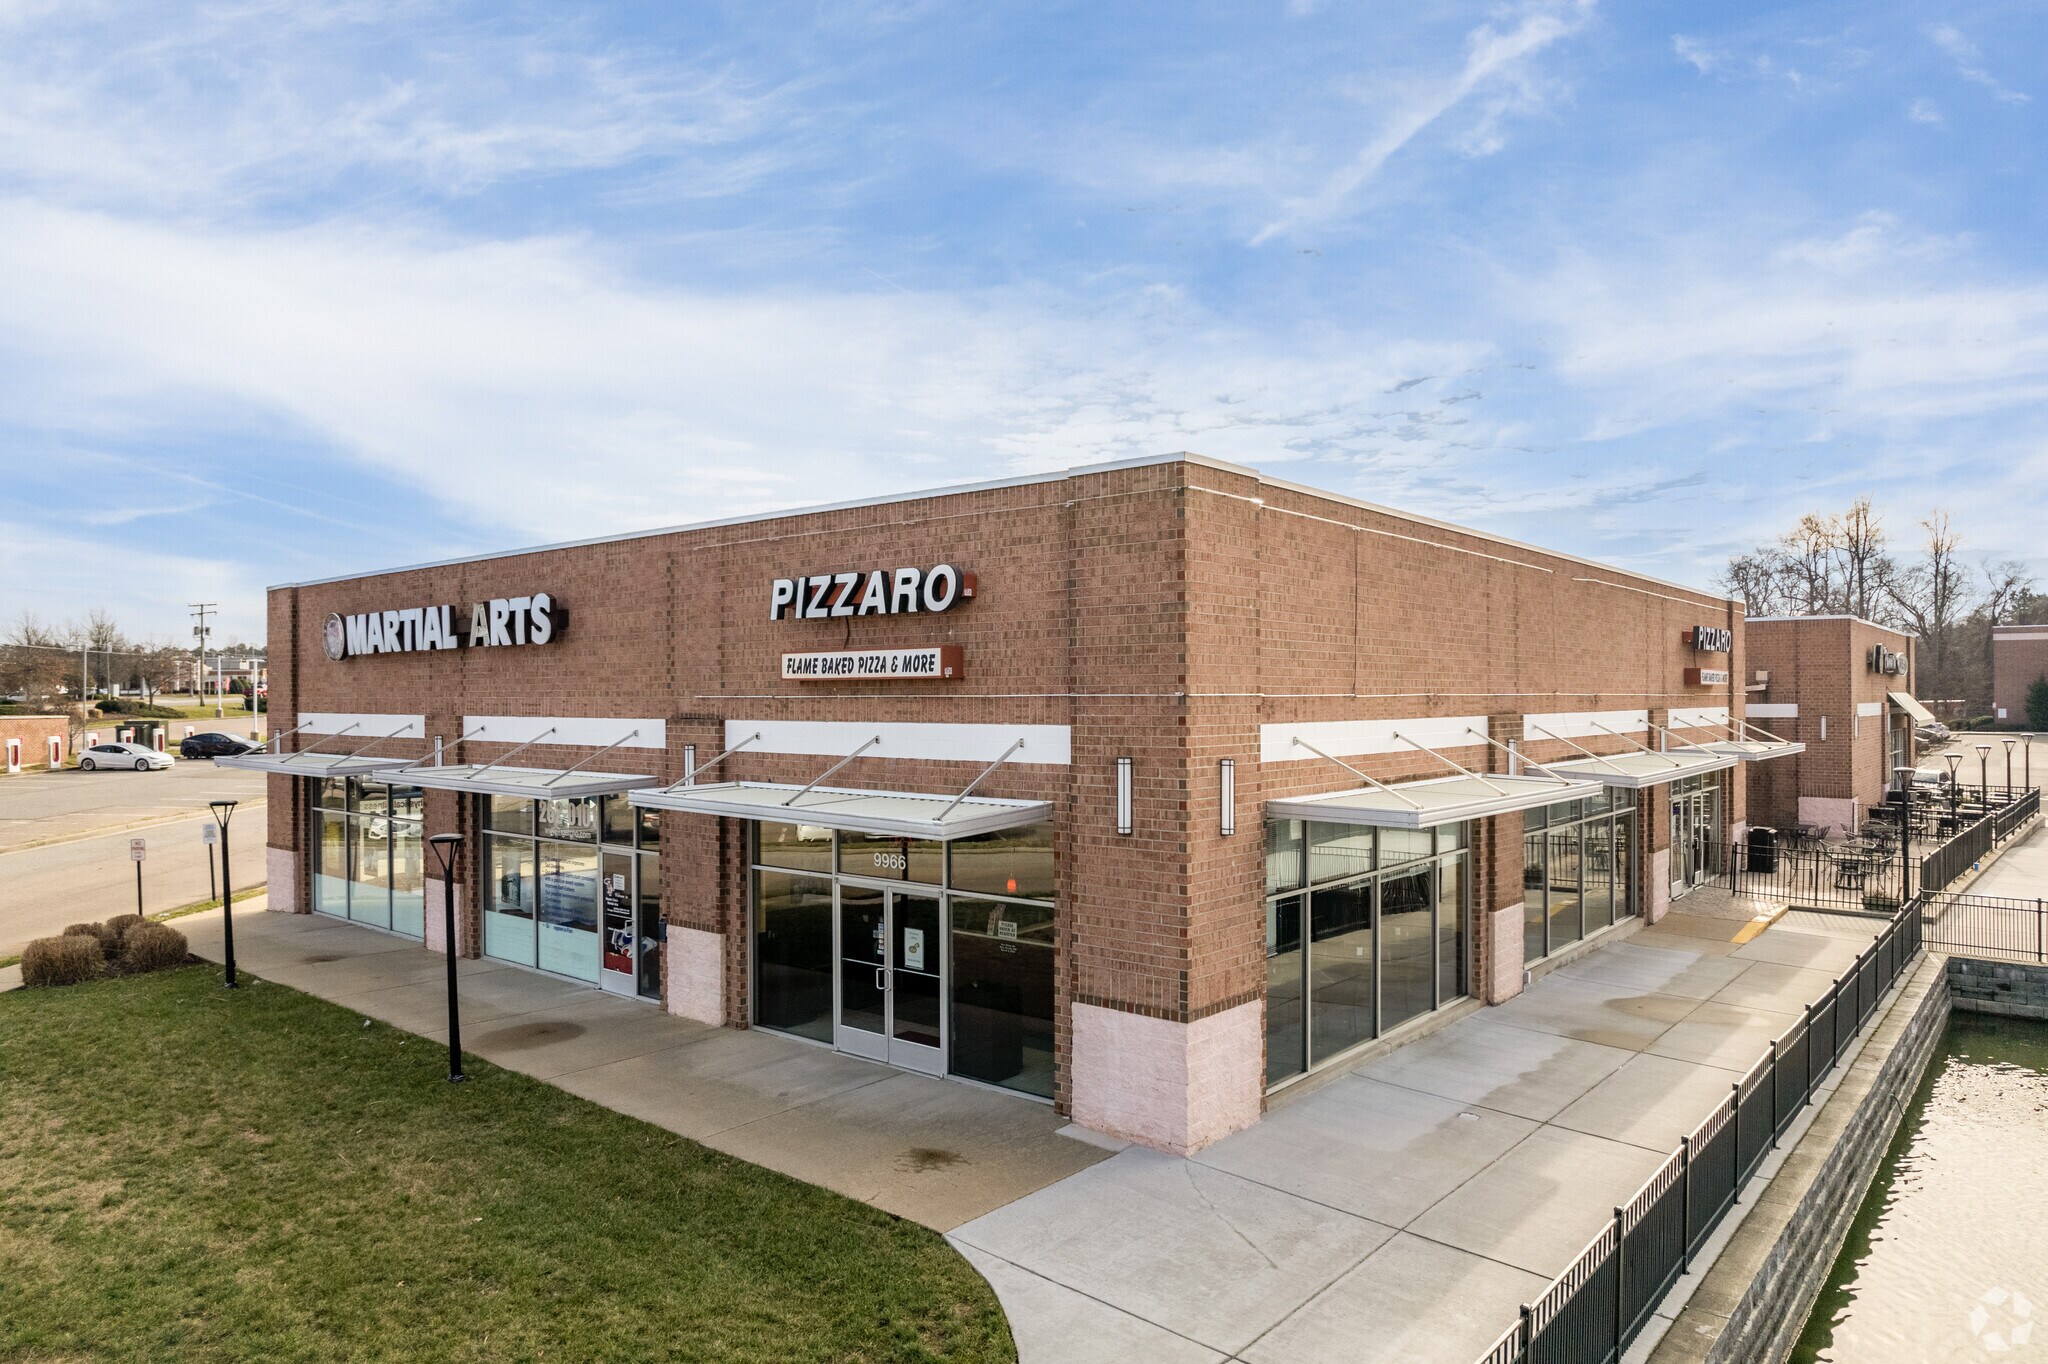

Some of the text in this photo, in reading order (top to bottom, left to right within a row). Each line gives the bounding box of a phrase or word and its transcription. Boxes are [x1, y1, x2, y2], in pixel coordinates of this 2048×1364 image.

[770, 564, 957, 620] PIZZARO
[346, 593, 552, 656] MARTIAL ARTS
[1698, 626, 1731, 653] PIZZARO
[786, 653, 936, 675] FLAME BAKED PIZZA & MORE
[874, 852, 906, 870] 9966
